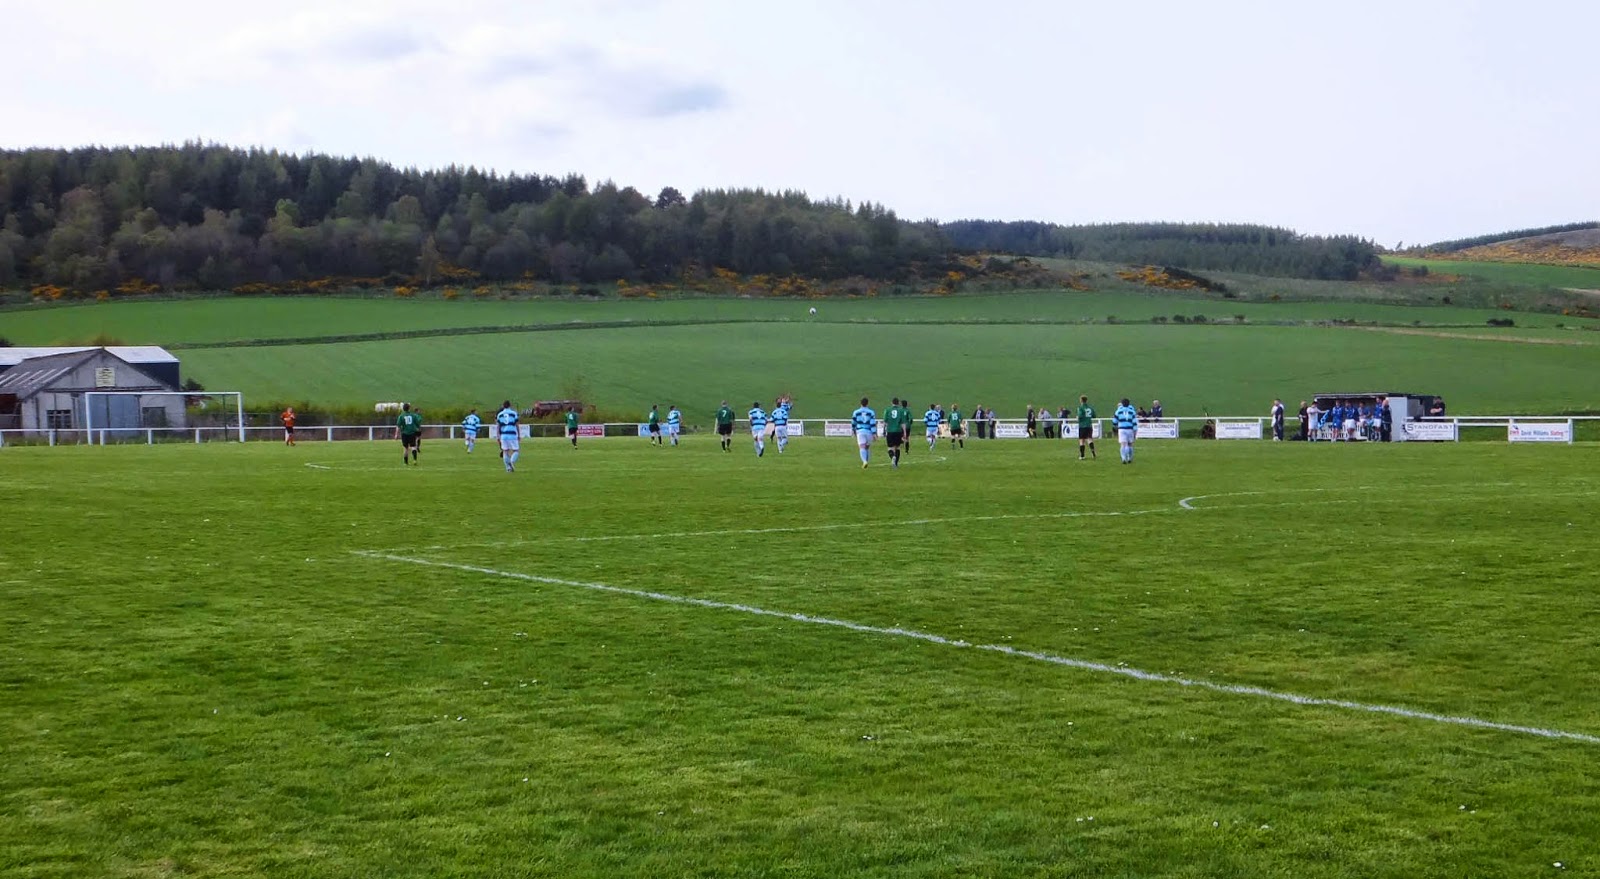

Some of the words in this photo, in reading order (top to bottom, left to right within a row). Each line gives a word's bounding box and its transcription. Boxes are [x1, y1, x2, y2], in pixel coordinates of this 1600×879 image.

[722, 409, 727, 418] 7
[891, 409, 898, 419] 9
[1085, 408, 1092, 417] 12
[404, 415, 412, 425] 10
[1407, 423, 1453, 431] STANDFAST
